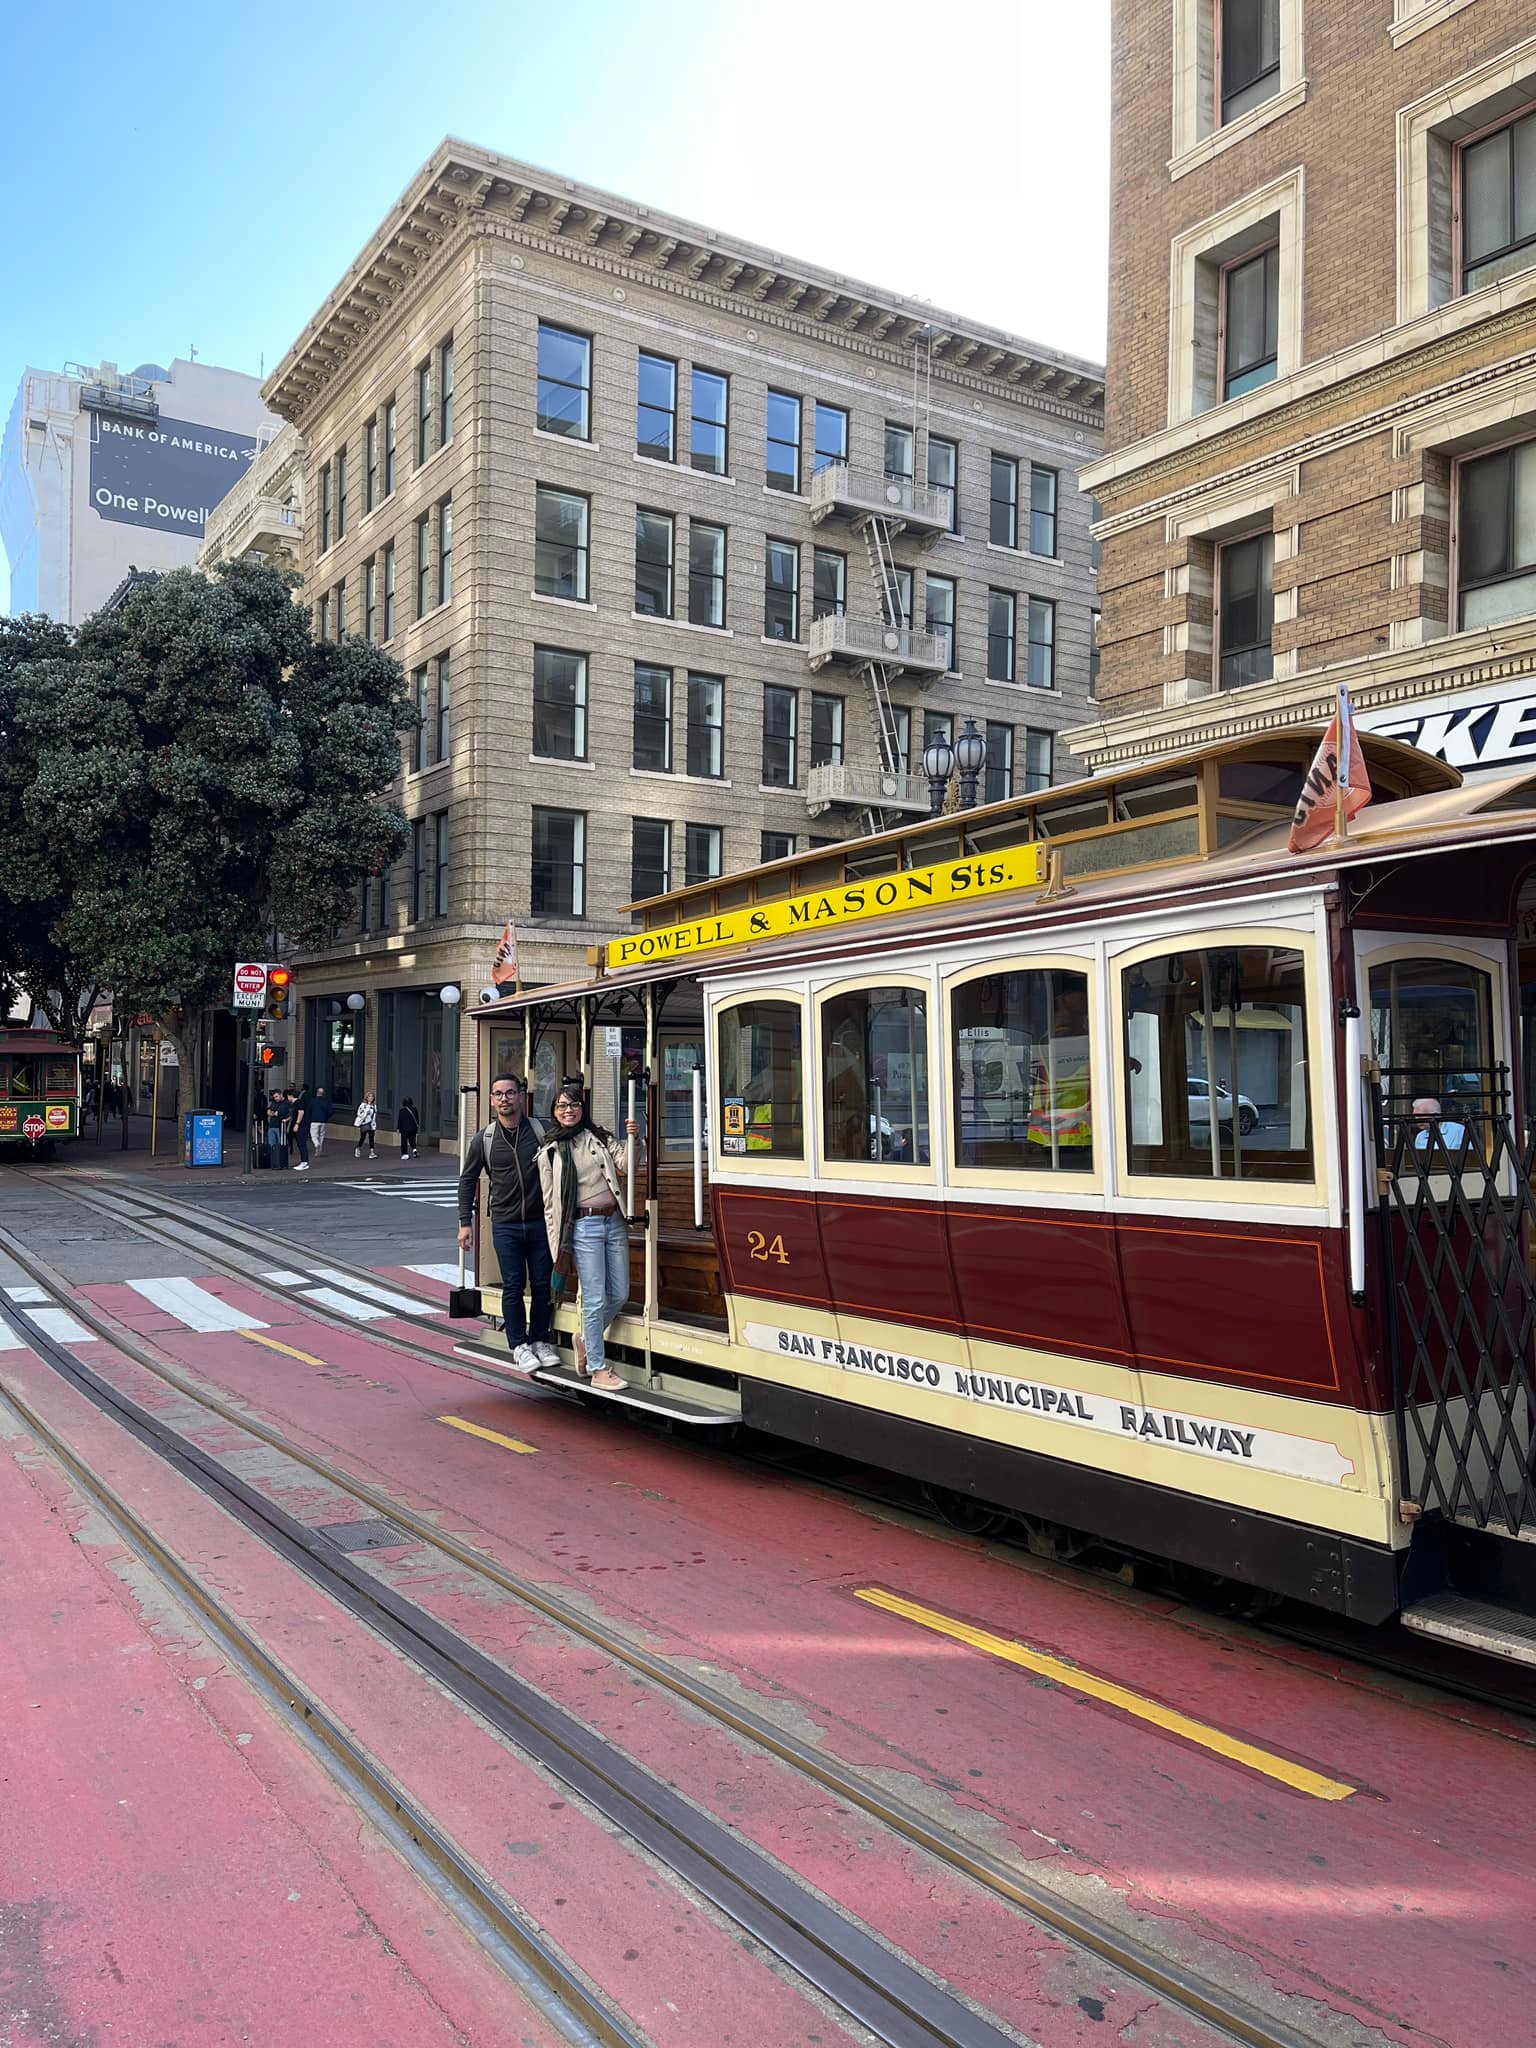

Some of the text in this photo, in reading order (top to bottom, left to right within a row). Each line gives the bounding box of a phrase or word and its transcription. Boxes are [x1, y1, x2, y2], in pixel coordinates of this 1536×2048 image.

[102, 421, 238, 461] BANK OF AMERICA
[95, 488, 209, 525] One Powell
[620, 862, 1013, 961] POWELL & MASON Sts.
[967, 1027, 989, 1037] Ellis
[24, 1123, 45, 1132] STOP
[747, 1231, 790, 1265] 24
[778, 1331, 1256, 1458] SAN FRANCISCO MUNICIPAL RAILWAY
